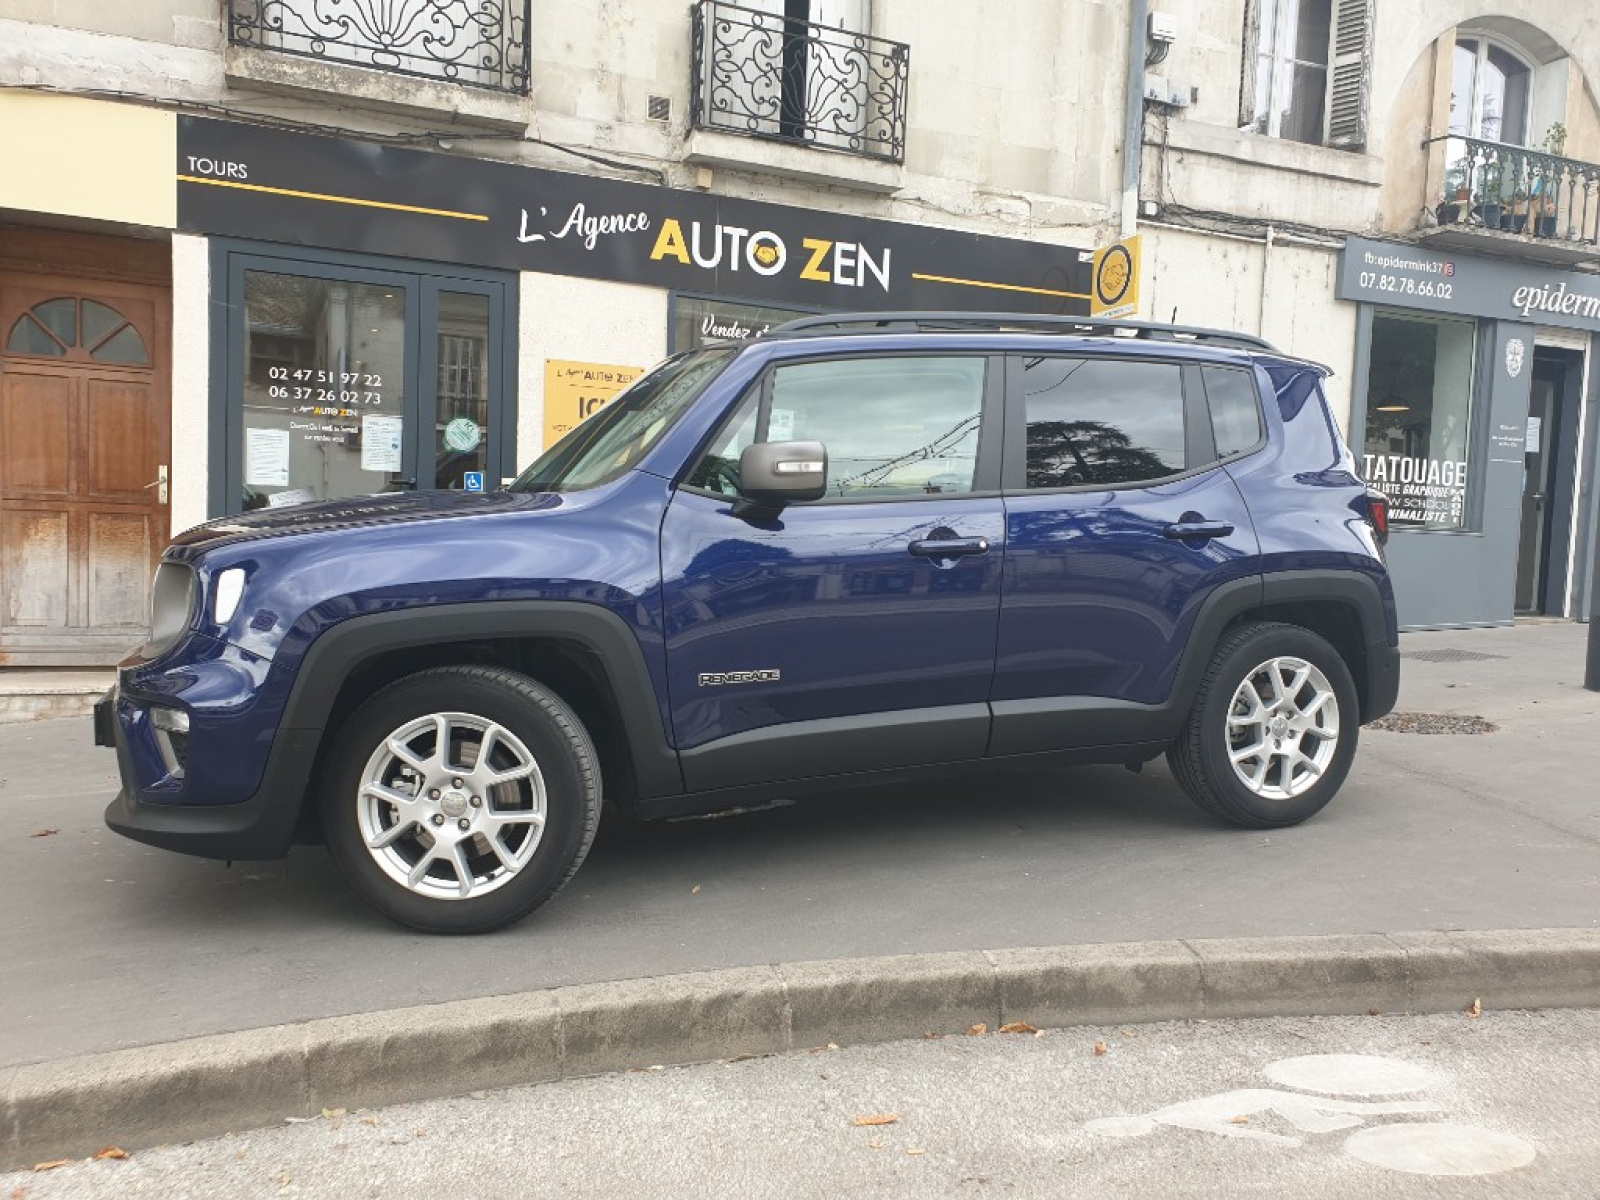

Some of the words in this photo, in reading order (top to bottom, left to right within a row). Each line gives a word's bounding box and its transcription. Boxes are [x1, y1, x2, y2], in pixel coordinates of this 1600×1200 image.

[187, 155, 248, 179] TOURS
[516, 205, 548, 243] L'
[549, 202, 651, 251] Agence
[650, 218, 788, 277] AUTO
[799, 237, 892, 293] ZEN
[1359, 271, 1453, 300] 07.82.78.66.02
[702, 313, 751, 340] Vendez
[268, 366, 289, 381] 02
[293, 369, 314, 382] 47
[317, 369, 334, 384] 51
[340, 372, 360, 385] 97
[363, 374, 383, 387] 22
[584, 371, 614, 382] AUTO
[268, 385, 289, 399] 06
[293, 386, 313, 400] 37
[316, 388, 336, 402] 26
[340, 390, 359, 404] 02
[363, 391, 382, 405] 73
[579, 396, 606, 419] IC
[1363, 454, 1466, 487] TATOUAGE
[1402, 483, 1450, 499] GRAPHIQUE
[1403, 498, 1450, 510] SCHOOL
[1388, 508, 1448, 523] NIMALISTE
[697, 668, 781, 687] RENEGADE
